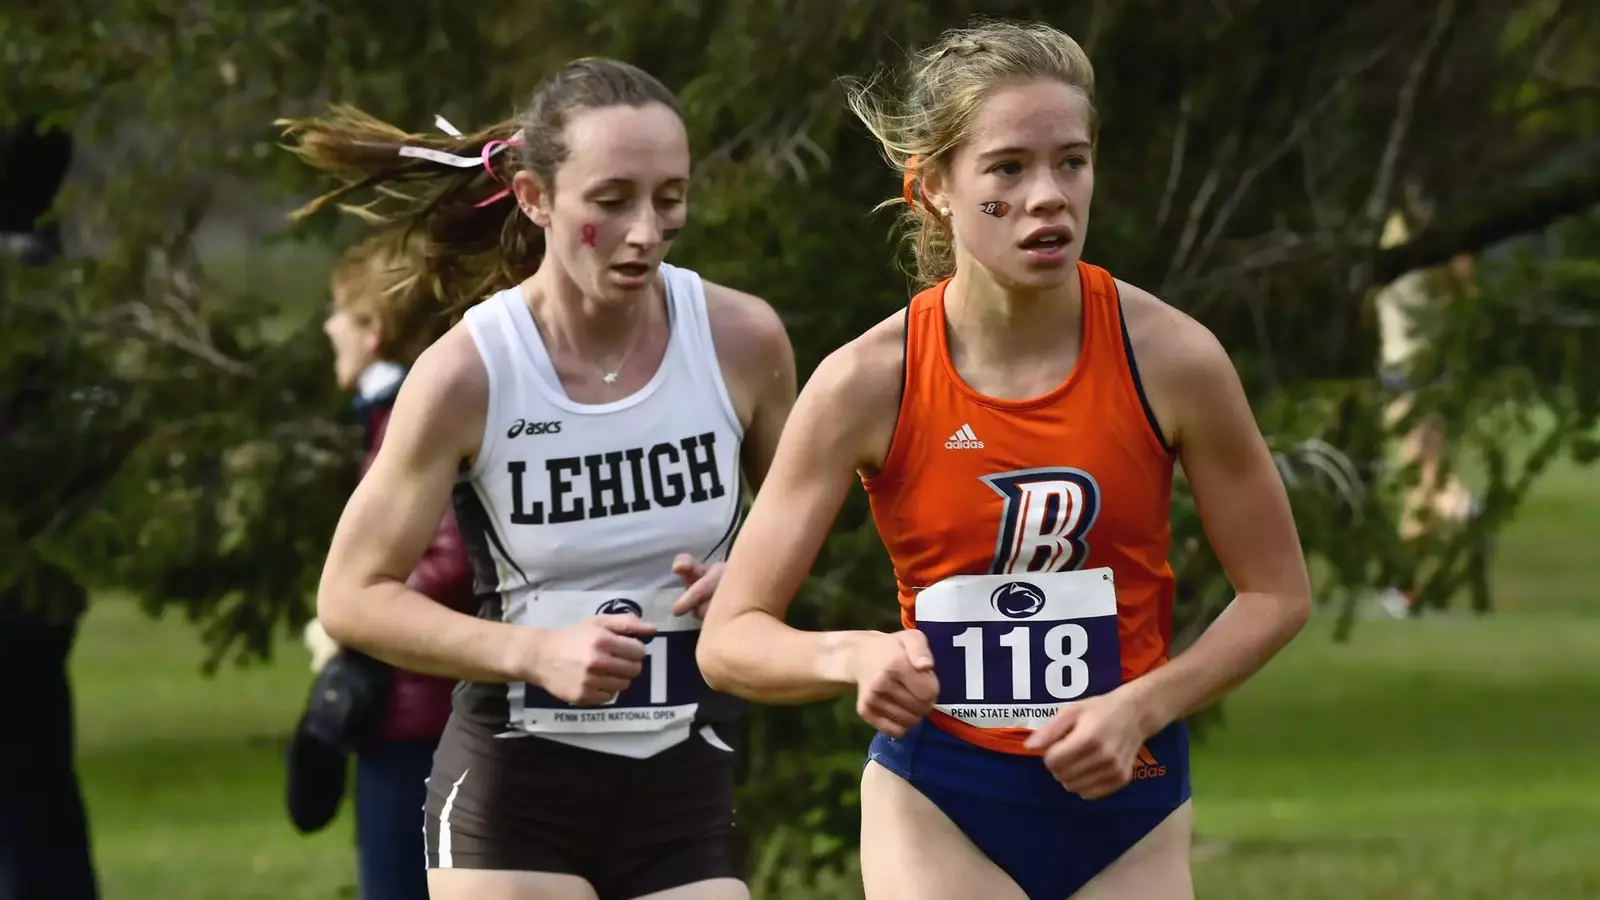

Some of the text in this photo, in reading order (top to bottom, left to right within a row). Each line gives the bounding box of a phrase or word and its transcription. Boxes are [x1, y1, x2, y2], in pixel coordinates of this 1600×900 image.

[525, 421, 562, 435] asics
[944, 439, 985, 449] adidas
[508, 432, 725, 525] LEHIGH
[977, 466, 1101, 575] B
[952, 623, 1089, 700] 118
[554, 710, 675, 722] PENN STATE NATIONAL OPEN
[951, 707, 1059, 718] PENN STATE NATIONA
[1133, 765, 1167, 780] idas
